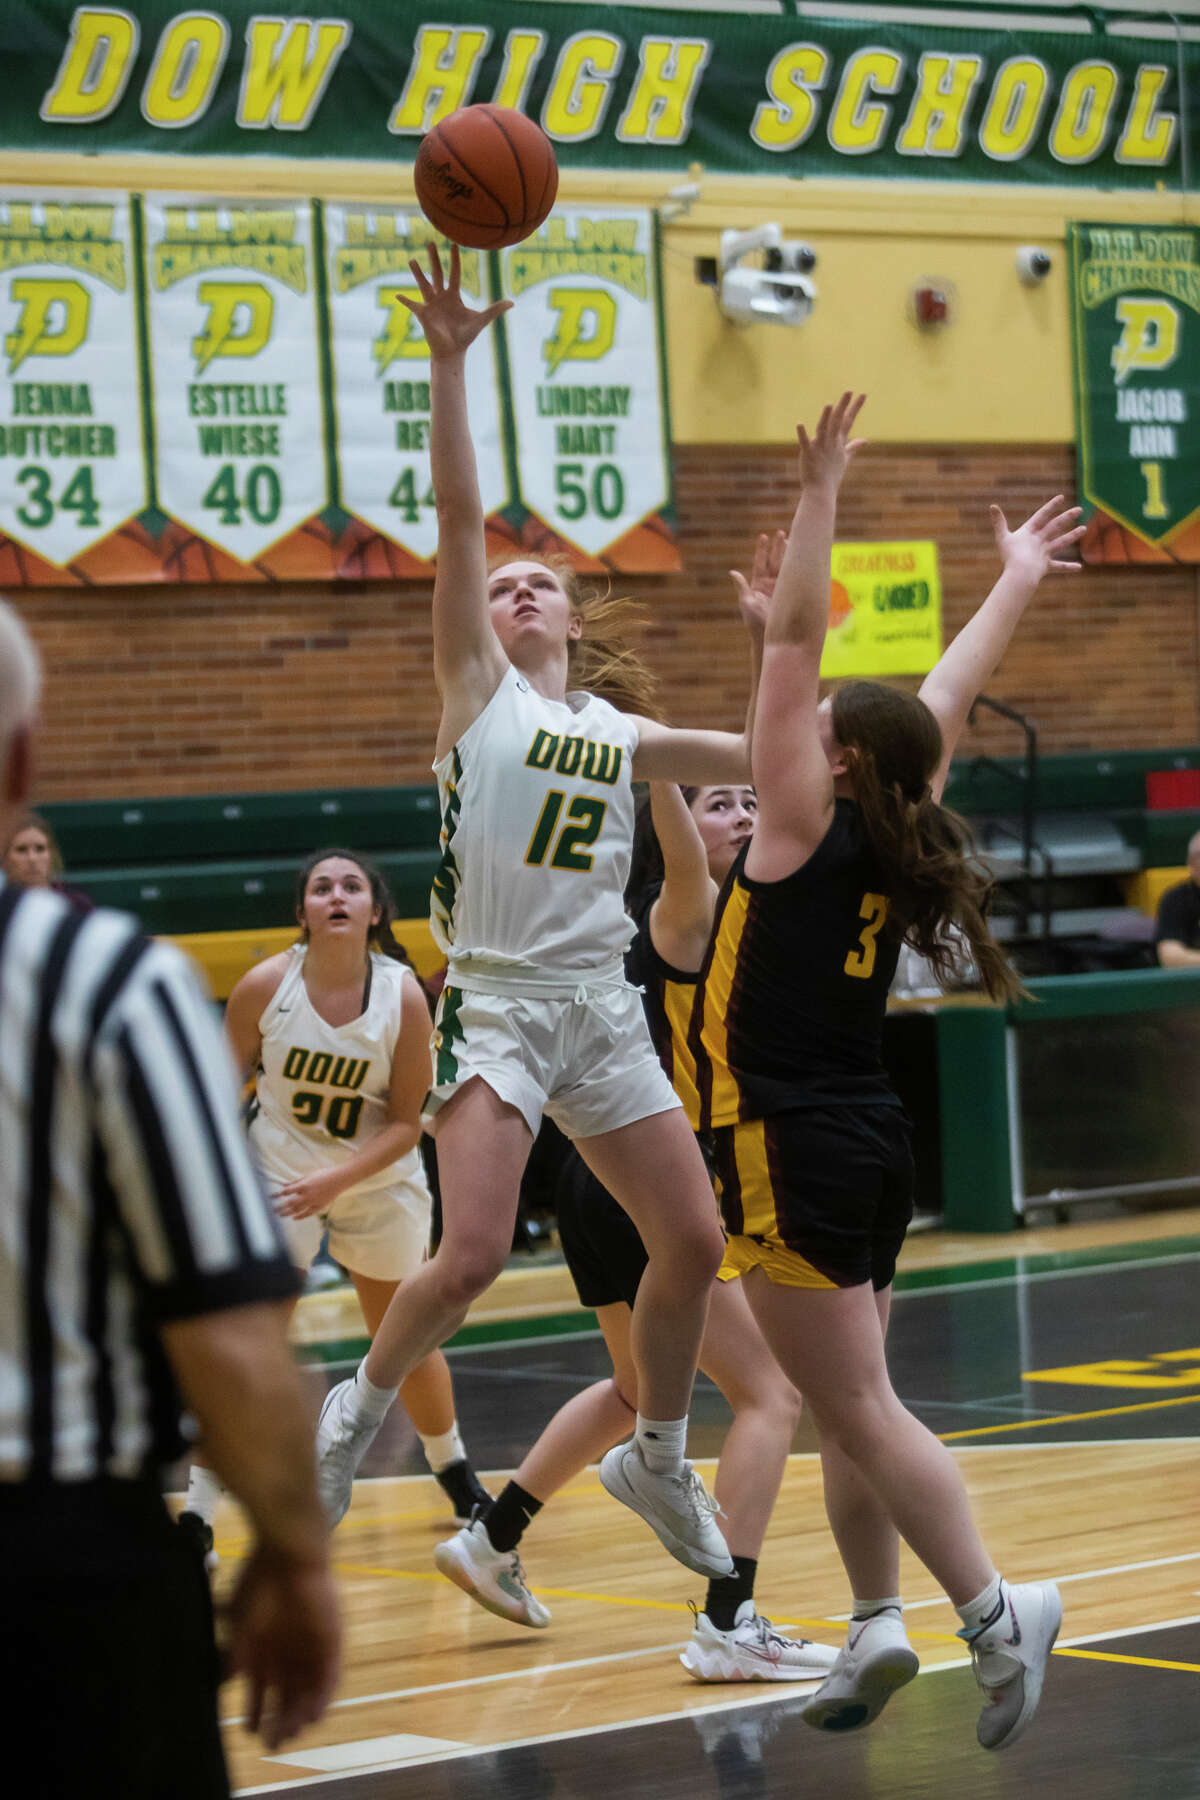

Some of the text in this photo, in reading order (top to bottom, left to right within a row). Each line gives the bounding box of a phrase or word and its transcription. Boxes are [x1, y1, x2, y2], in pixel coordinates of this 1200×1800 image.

[40, 7, 1176, 165] DOW HIGH SCHOOL
[12, 382, 93, 417] JENNA
[188, 382, 288, 417] ESTELLE
[384, 381, 431, 413] ABB
[536, 385, 632, 418] LINDSAY
[1115, 389, 1186, 422] JACOB
[198, 424, 281, 457] WIESE
[555, 423, 616, 456] HART
[15, 464, 101, 528] 34
[202, 463, 282, 526] 40
[554, 462, 625, 521] 50
[1140, 462, 1168, 518] 1
[524, 727, 623, 786] DOW
[523, 788, 608, 873] 12
[843, 892, 889, 979] 3
[282, 1045, 371, 1091] DOW
